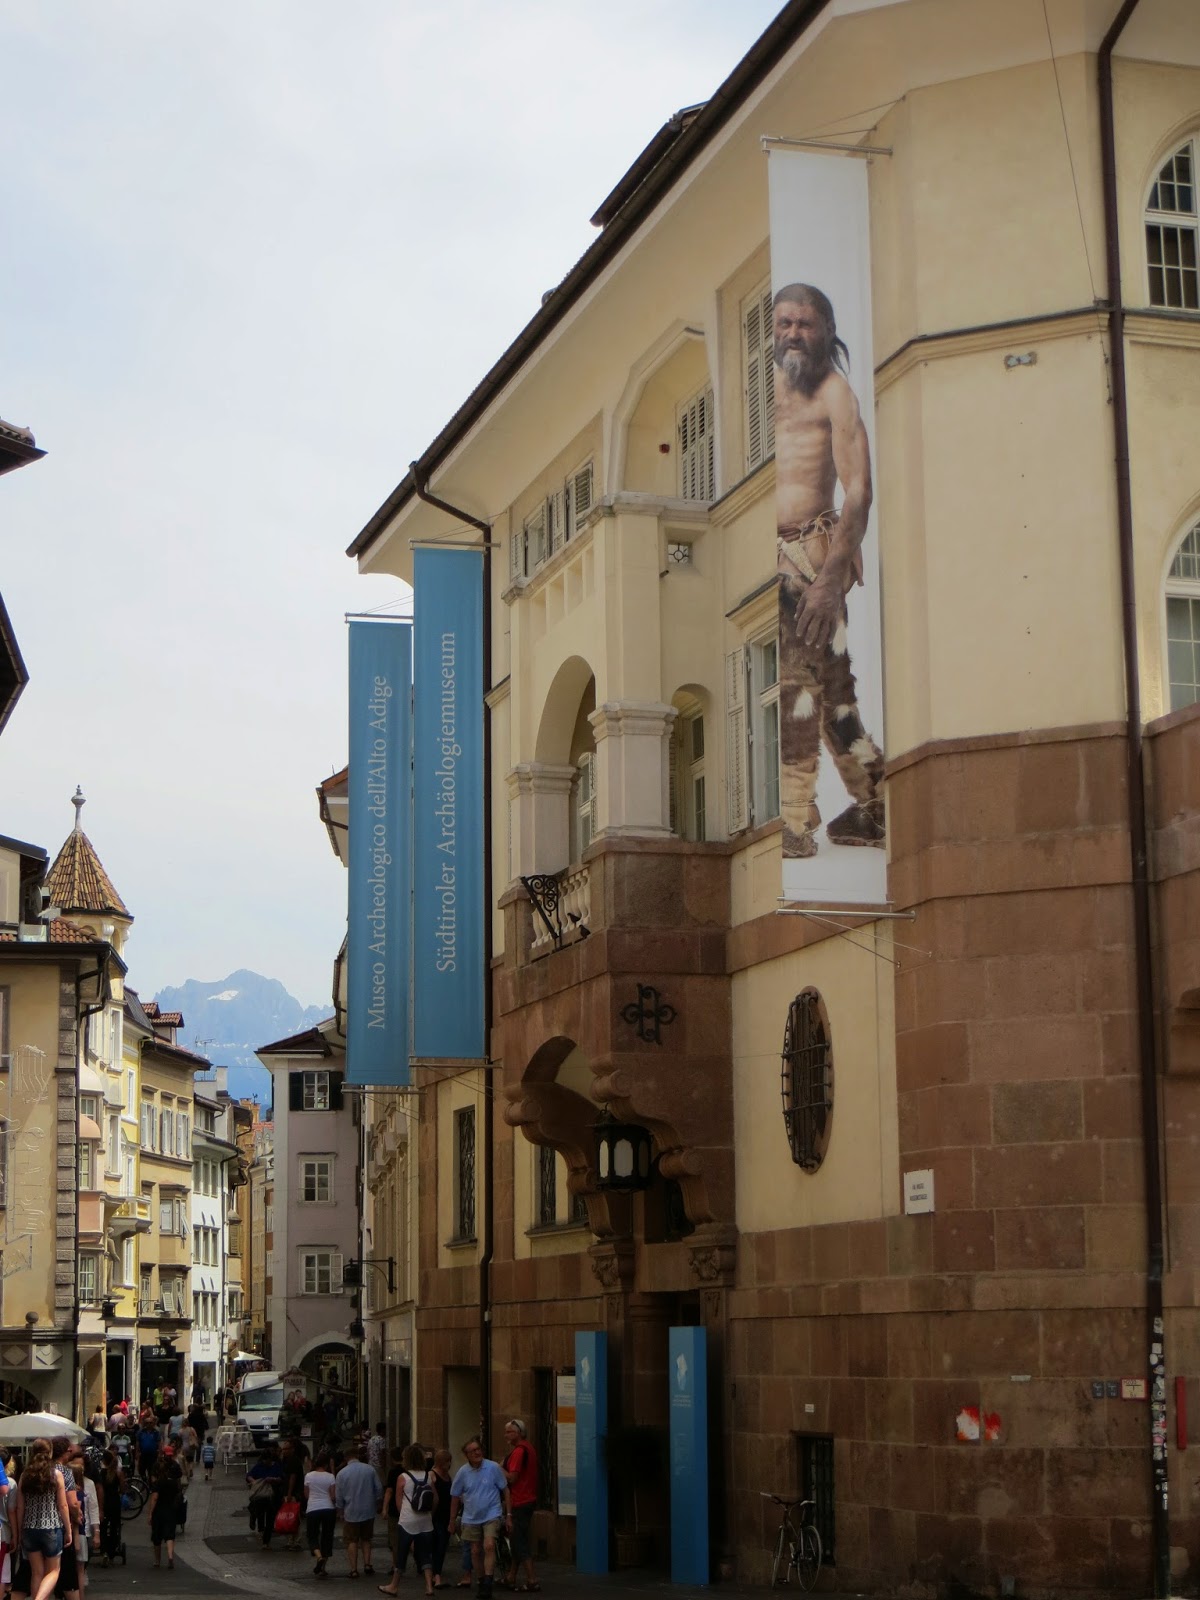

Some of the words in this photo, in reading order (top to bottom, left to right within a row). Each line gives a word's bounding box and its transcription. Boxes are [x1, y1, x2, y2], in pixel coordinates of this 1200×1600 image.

[367, 675, 392, 732] Adige
[435, 632, 461, 856] Archäologiemuseum
[367, 738, 387, 817] dell'Alto
[367, 823, 391, 955] Archeologico
[435, 863, 456, 972] Südtiroler
[367, 962, 386, 1029] Museo
